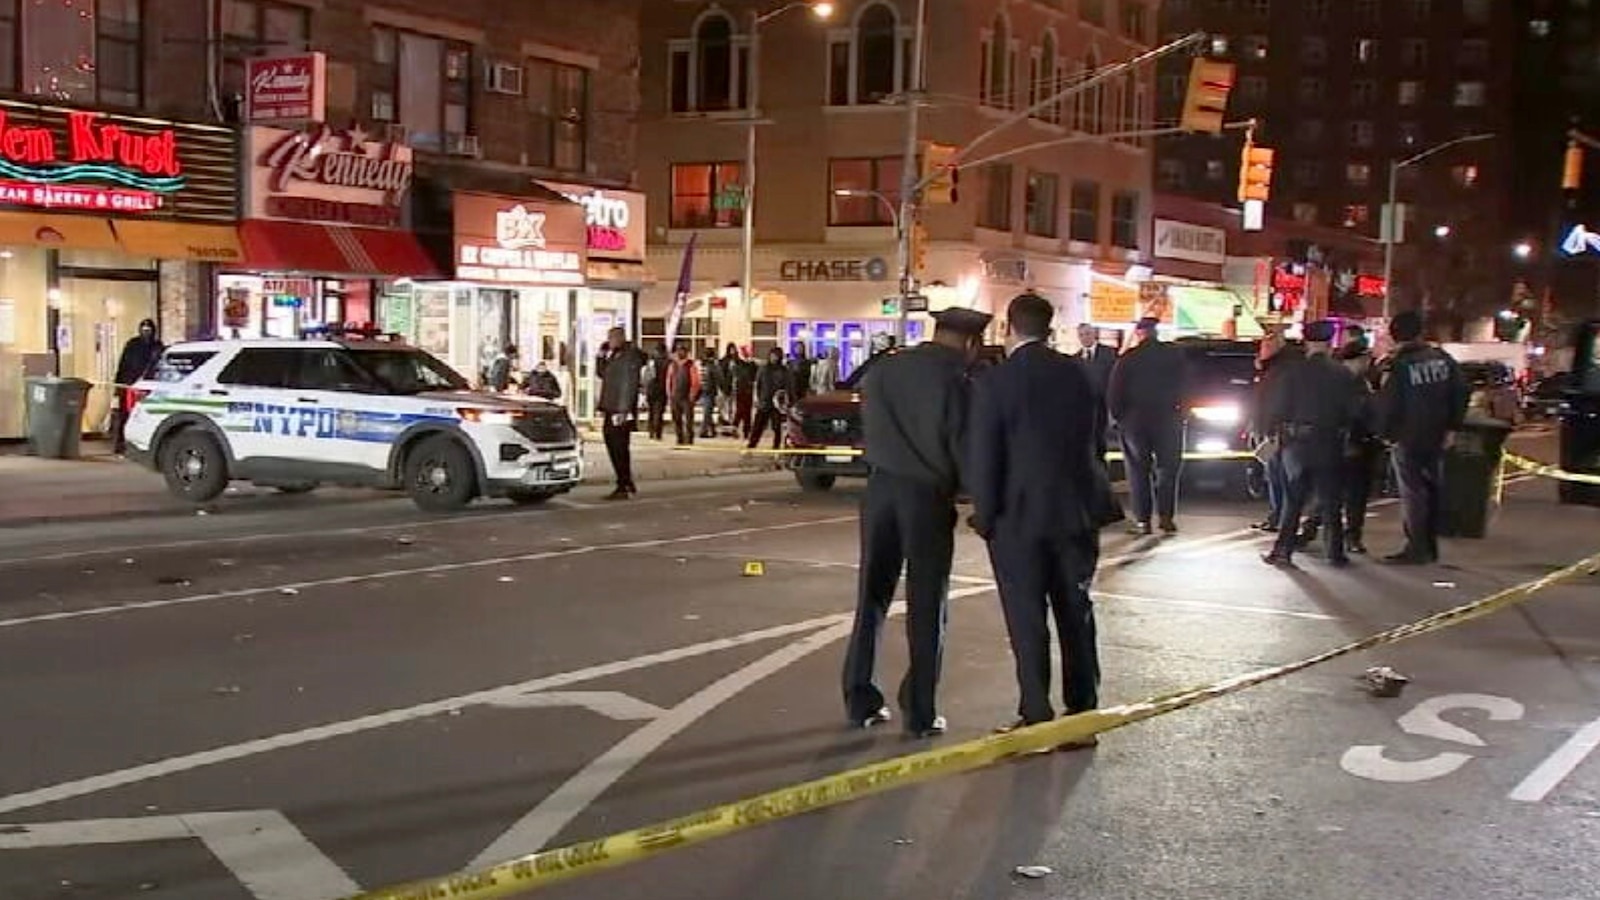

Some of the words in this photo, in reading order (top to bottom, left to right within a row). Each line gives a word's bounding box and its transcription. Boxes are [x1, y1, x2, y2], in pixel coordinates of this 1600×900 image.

[70, 111, 180, 177] Krust
[266, 125, 413, 205] Kennedy
[112, 195, 153, 209] GRILL
[562, 190, 629, 229] etro
[780, 260, 862, 281] CHASE
[1408, 360, 1448, 386] NYPD
[253, 403, 335, 438] NYPD
